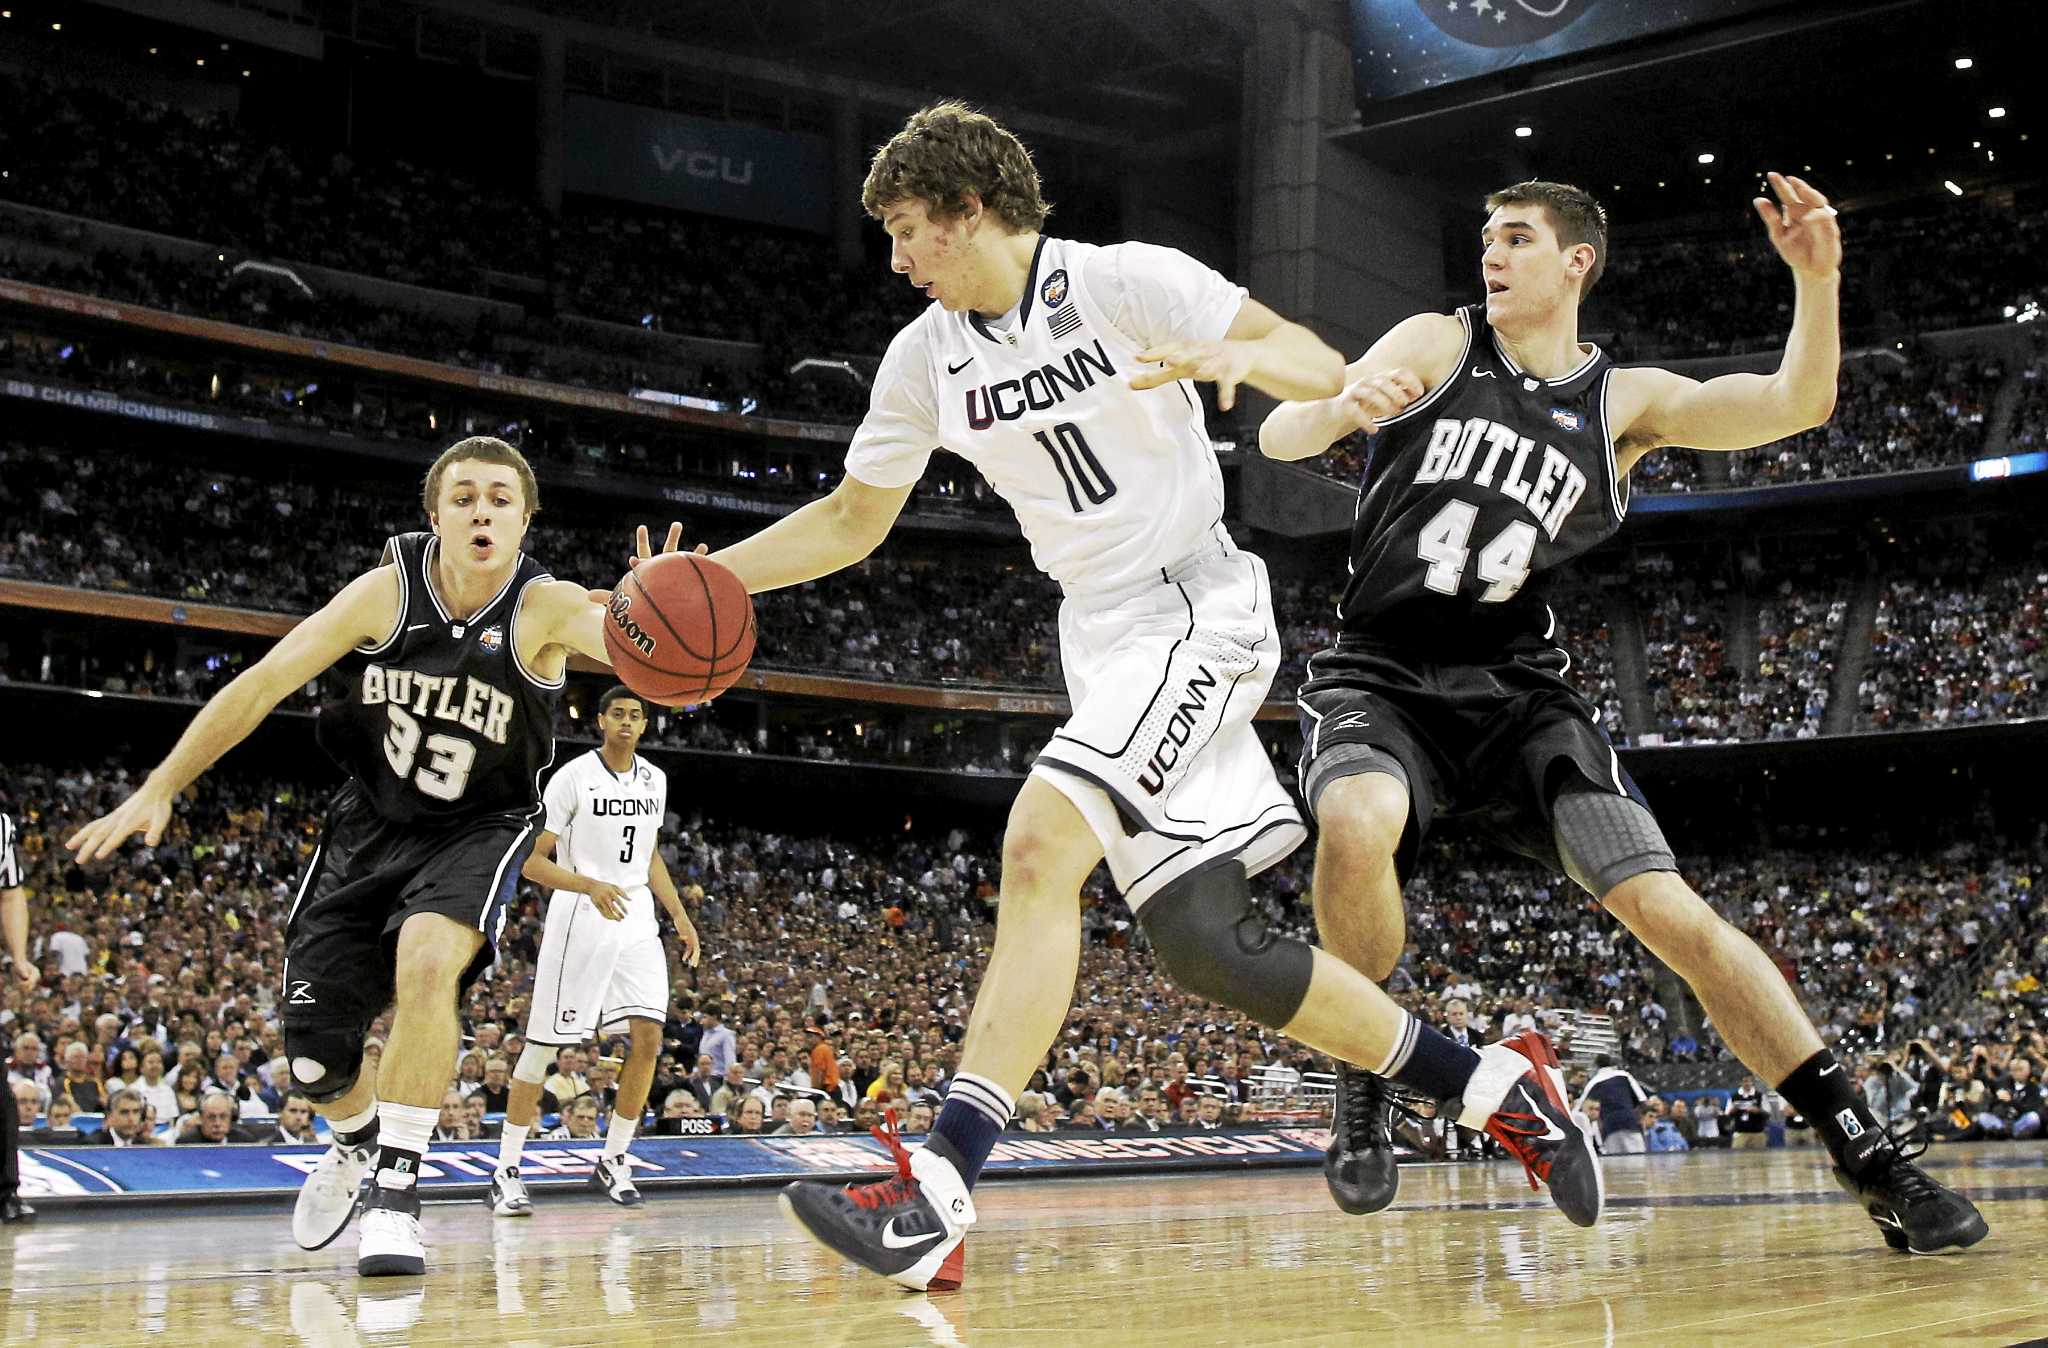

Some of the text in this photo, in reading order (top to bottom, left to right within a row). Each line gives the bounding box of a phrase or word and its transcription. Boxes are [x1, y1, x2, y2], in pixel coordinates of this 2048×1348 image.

[652, 144, 754, 185] VCU
[966, 338, 1117, 430] UCONN
[1032, 422, 1117, 512] 10
[1412, 417, 1587, 543] BUTLER
[1417, 498, 1538, 604] 44
[362, 664, 514, 744] BUTLER
[1137, 664, 1217, 796] UCONN
[383, 703, 477, 801] 33
[593, 798, 660, 816] UCONN
[620, 825, 636, 864] 3
[681, 1119, 713, 1134] POSS
[985, 1134, 1304, 1161] NNECTICUT
